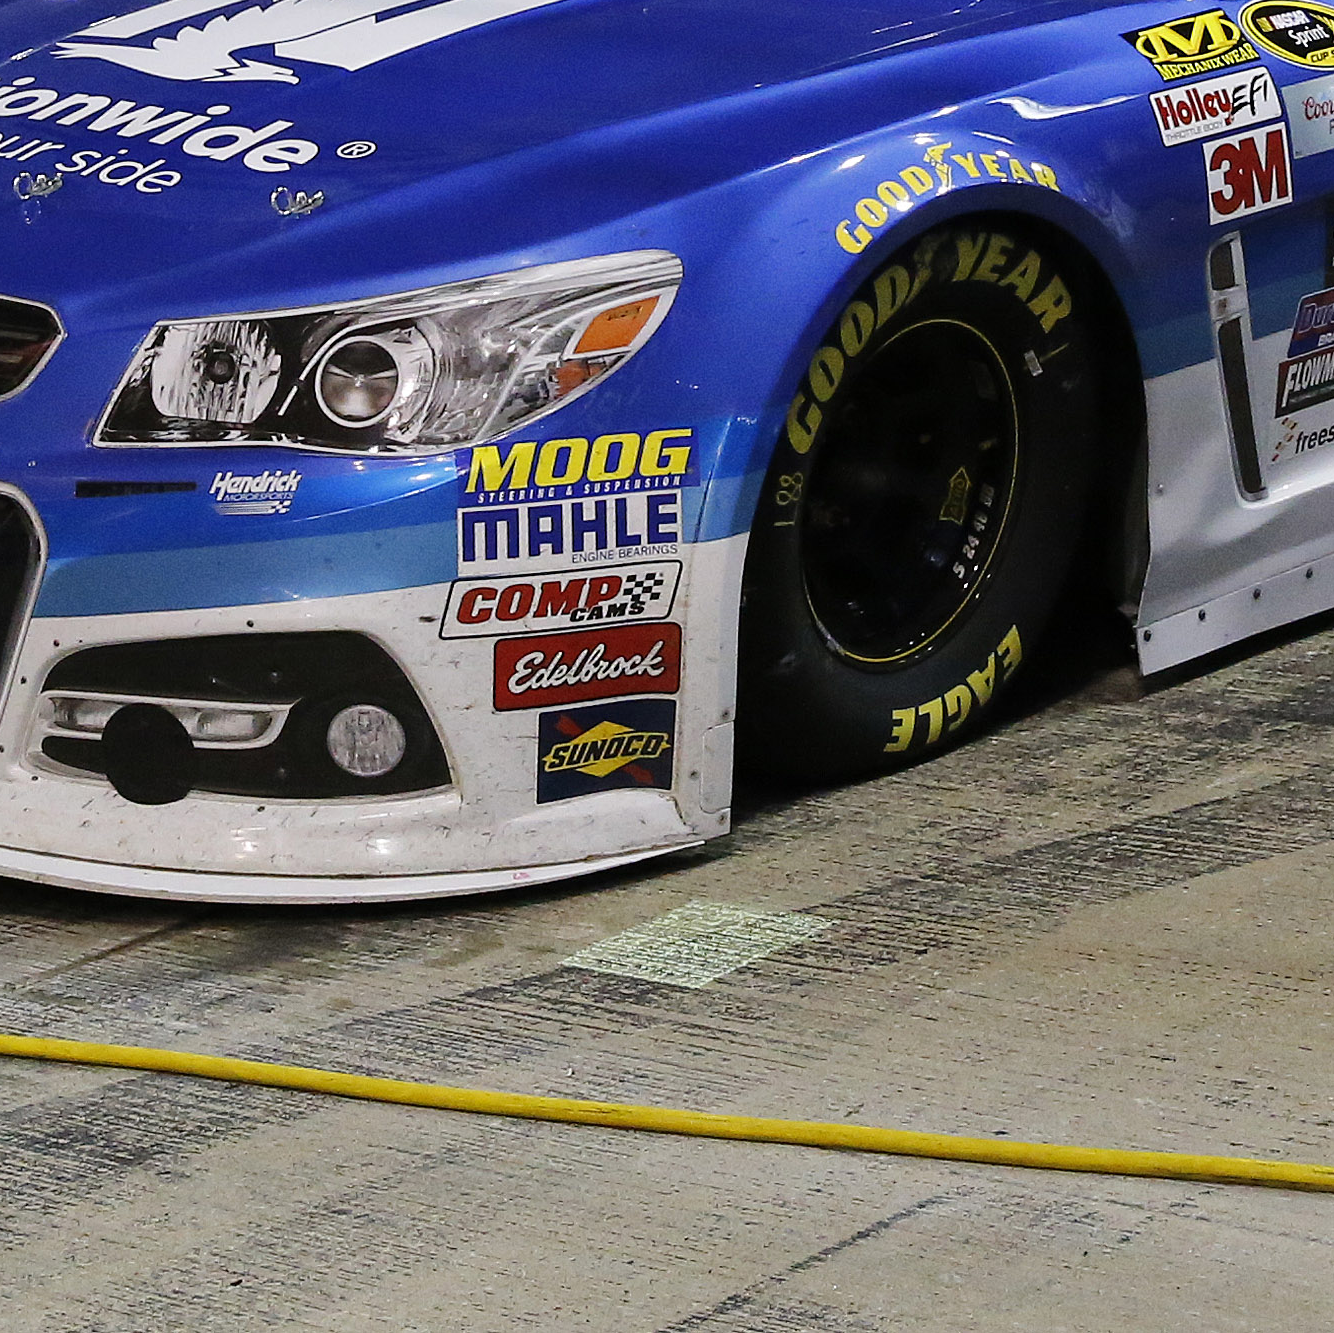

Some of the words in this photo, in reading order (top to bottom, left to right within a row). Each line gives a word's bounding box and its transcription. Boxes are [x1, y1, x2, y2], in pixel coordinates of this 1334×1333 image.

[1269, 9, 1311, 30] NASCAR
[1287, 23, 1331, 48] Sprint
[1153, 58, 1225, 81] MECHANIX
[1220, 42, 1260, 66] WEAR
[1310, 52, 1329, 63] CUP
[1154, 87, 1234, 131] Holley
[1230, 72, 1268, 117] EFI
[1165, 125, 1203, 141] THROTTLE
[1202, 120, 1224, 133] BODY
[54, 147, 184, 194] side
[1208, 128, 1291, 217] 3M
[464, 427, 694, 494] MOOG
[208, 469, 303, 502] Hendrick
[476, 487, 556, 505] STEERING
[565, 485, 574, 497] &
[583, 475, 683, 497] SUSPENSION
[461, 492, 680, 563] MAHLE
[571, 549, 615, 565] ENGINE
[617, 542, 680, 560] BEARINGS
[456, 575, 624, 626] COMP
[568, 601, 647, 623] CAMS
[507, 639, 666, 695] Edelbrock
[881, 623, 1024, 754] EAGLE
[550, 731, 666, 769] SUNOCO
